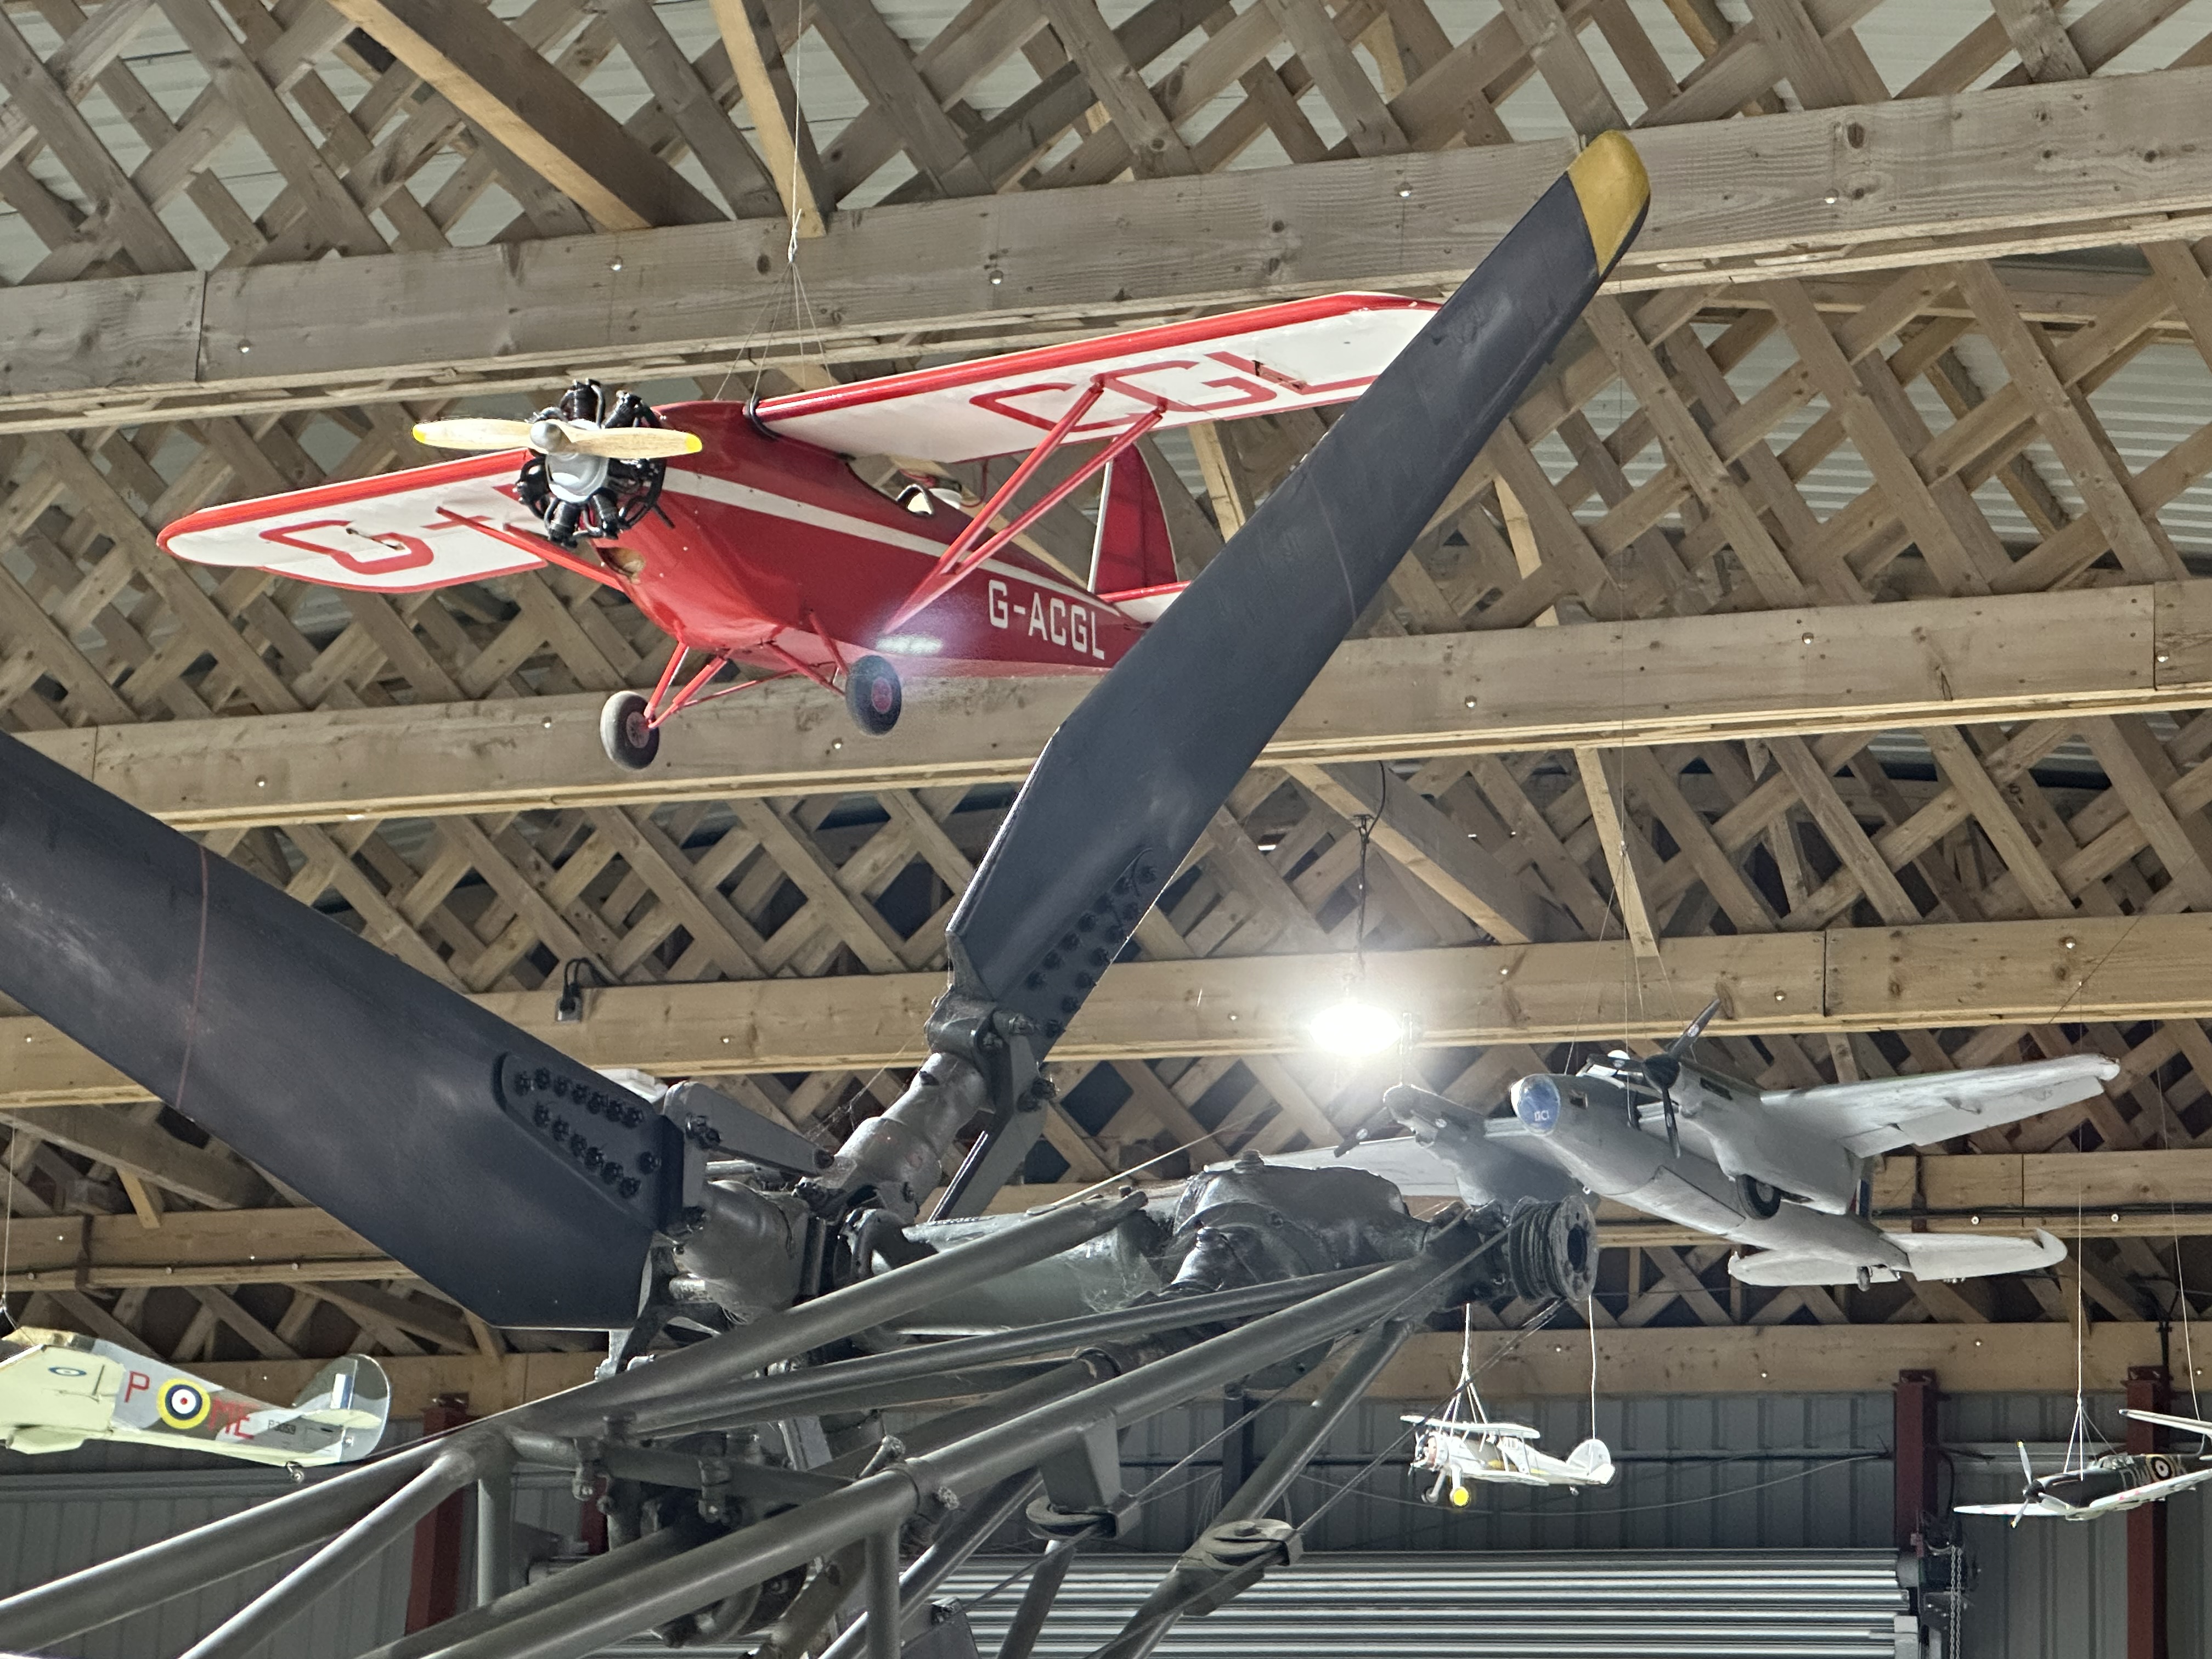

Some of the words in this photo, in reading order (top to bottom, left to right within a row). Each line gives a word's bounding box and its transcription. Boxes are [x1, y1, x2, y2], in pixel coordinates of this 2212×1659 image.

[969, 351, 1378, 433] CGL
[989, 579, 1104, 660] G-ACGL
[125, 1371, 150, 1403] P
[208, 1396, 260, 1440] ME
